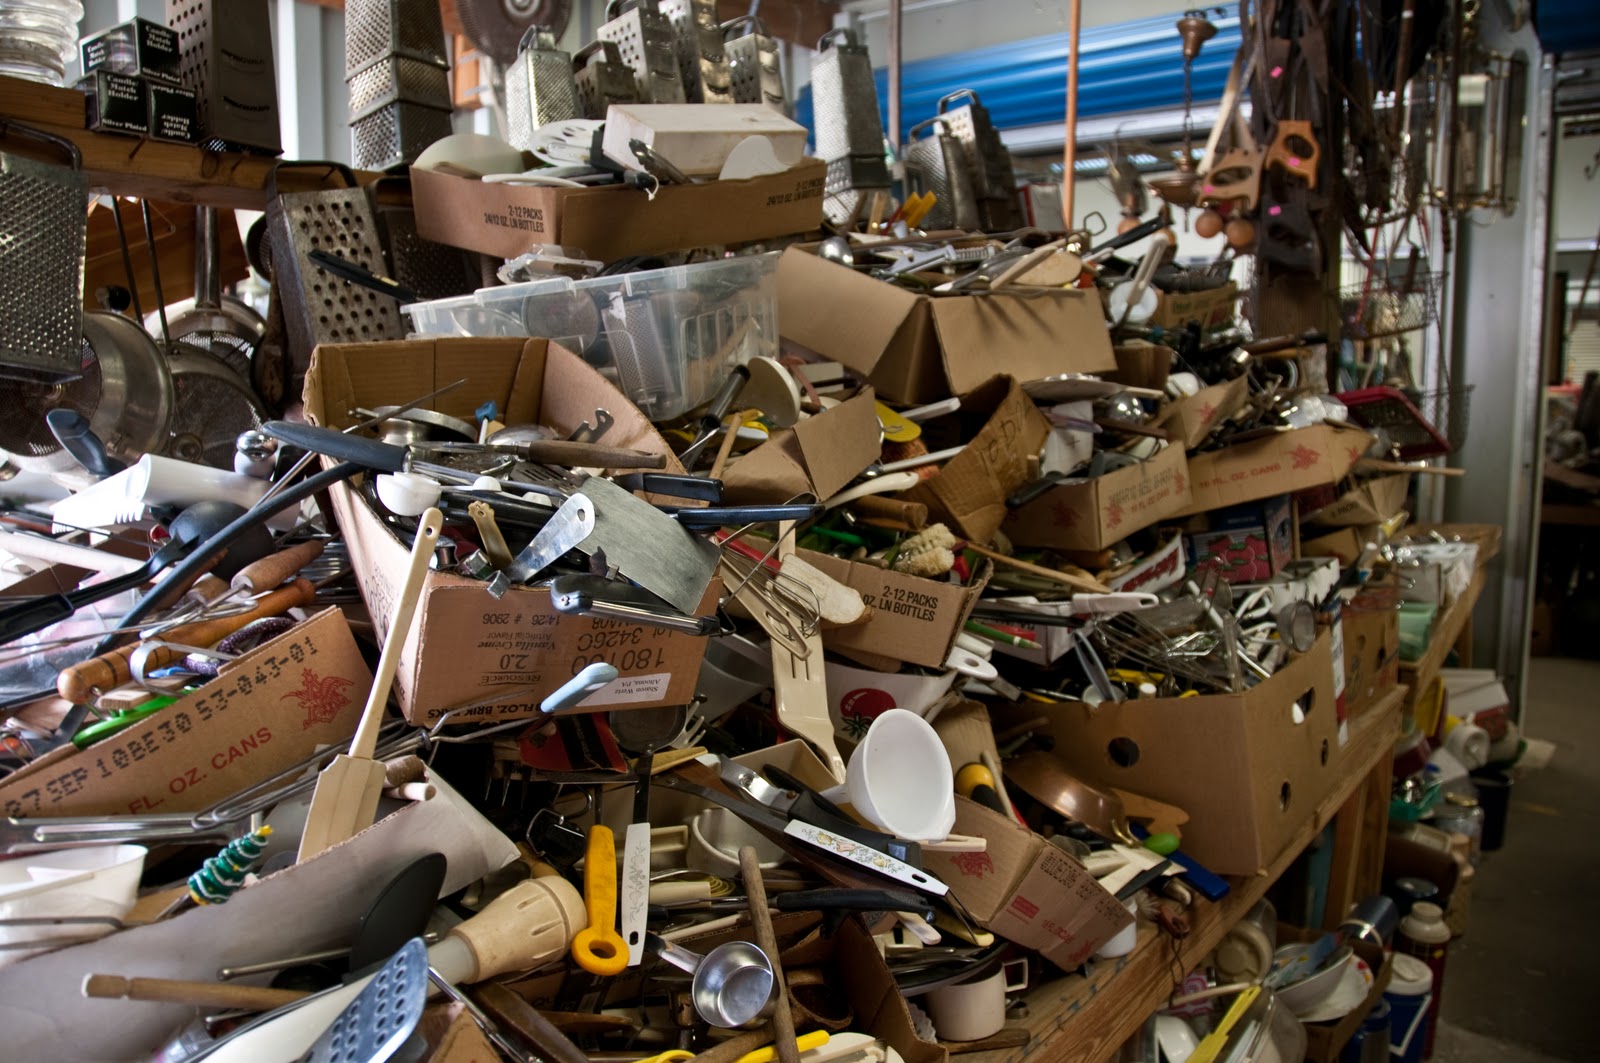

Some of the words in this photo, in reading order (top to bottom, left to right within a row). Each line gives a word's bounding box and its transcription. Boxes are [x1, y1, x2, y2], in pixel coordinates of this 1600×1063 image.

[149, 33, 171, 45] Match
[146, 39, 173, 53] Holder
[142, 67, 161, 77] Silver
[161, 72, 181, 84] Plated
[110, 82, 137, 94] Match
[107, 89, 139, 101] Holder
[102, 118, 124, 128] Silver
[124, 121, 147, 132] Plated
[161, 114, 190, 126] Holder
[163, 121, 188, 132] Match
[508, 204, 522, 218] 2-12
[522, 206, 543, 221] PACKS
[510, 217, 518, 229] LN
[518, 218, 545, 233] BOTTLES
[882, 585, 906, 602] 2-12
[906, 591, 939, 610] PACKS
[863, 594, 877, 608] OZ.
[878, 598, 893, 612] LN
[893, 602, 936, 622] BOTTLES
[482, 613, 511, 625] 2906
[513, 613, 522, 625] #
[531, 614, 560, 626] 14:26
[487, 632, 513, 640] Flavor
[516, 632, 552, 641] Artificial
[577, 627, 643, 652] 3426C
[477, 641, 513, 651] Crème
[515, 641, 555, 651] Vanilla
[500, 653, 529, 670] 2.0
[481, 674, 541, 684] RESOURCE
[614, 686, 634, 695] Wertz
[46, 767, 88, 803] SEP
[195, 636, 318, 721] 53-043-01
[127, 795, 167, 815] FL.
[169, 767, 208, 794] OZ.
[211, 727, 273, 770] CANS
